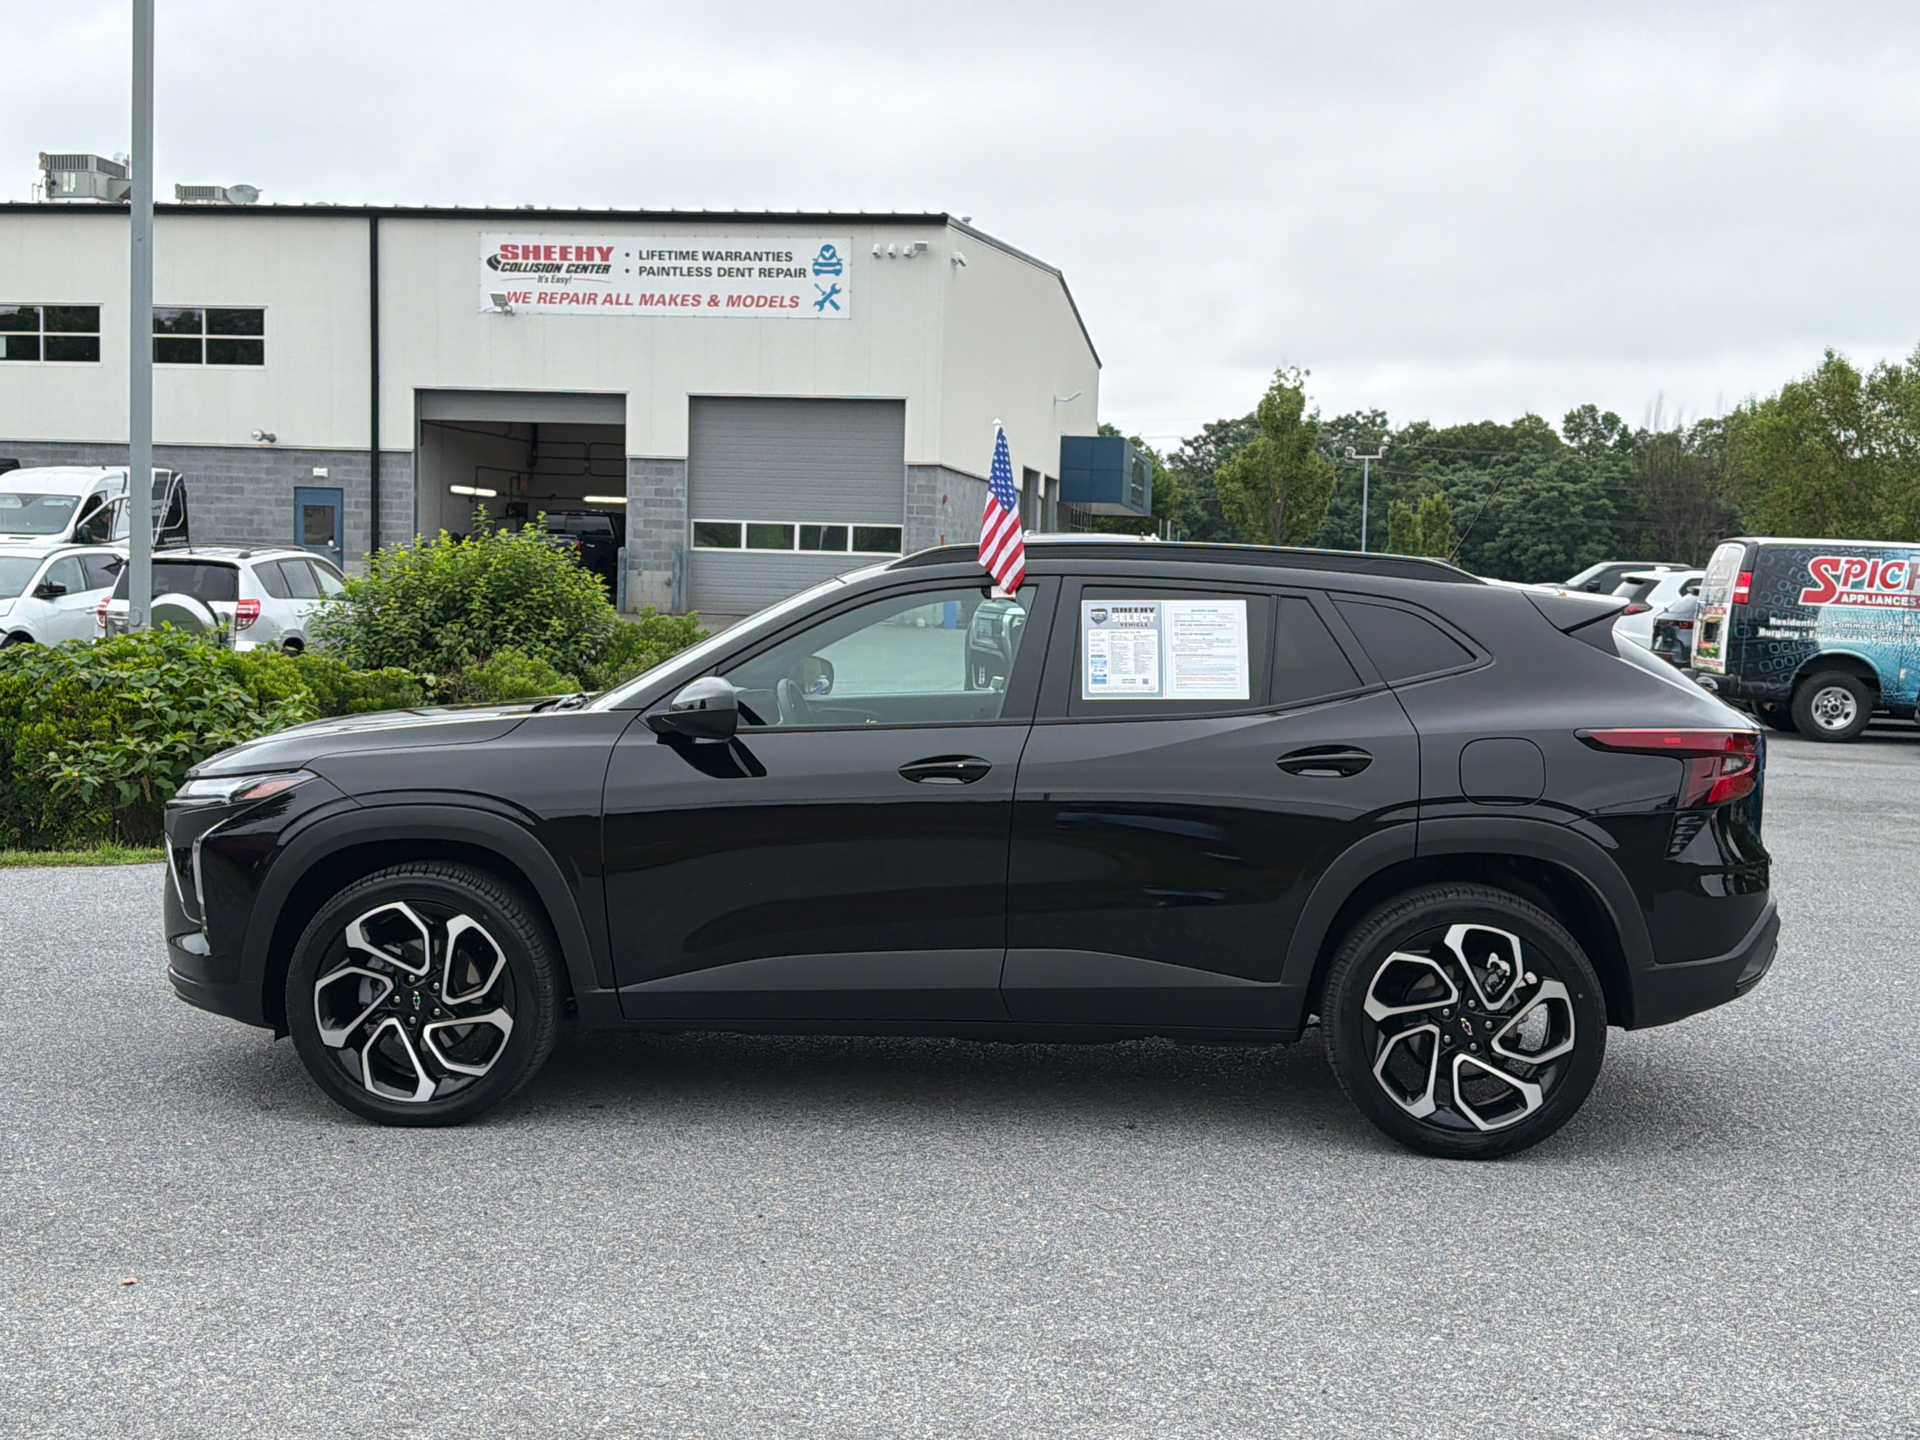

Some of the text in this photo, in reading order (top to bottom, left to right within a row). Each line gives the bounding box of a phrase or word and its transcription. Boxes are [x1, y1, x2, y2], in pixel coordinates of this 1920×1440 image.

[500, 244, 615, 262] SHEEHY
[639, 250, 793, 262] LIFETIME WARRANTIES
[500, 262, 612, 274] COLLISION CENTER
[639, 266, 807, 278] PAINTLESS DENT REPAIR
[537, 275, 572, 285] It's Easy!
[506, 291, 800, 308] WE REPAIR ALL MAKES & MODELS
[1841, 594, 1916, 606] APPLIANCES
[1111, 613, 1156, 623] SELECT
[1769, 617, 1822, 628] Residential
[1832, 621, 1888, 631] Commercial
[1758, 627, 1800, 639] Burglary
[1834, 632, 1868, 641] Access
